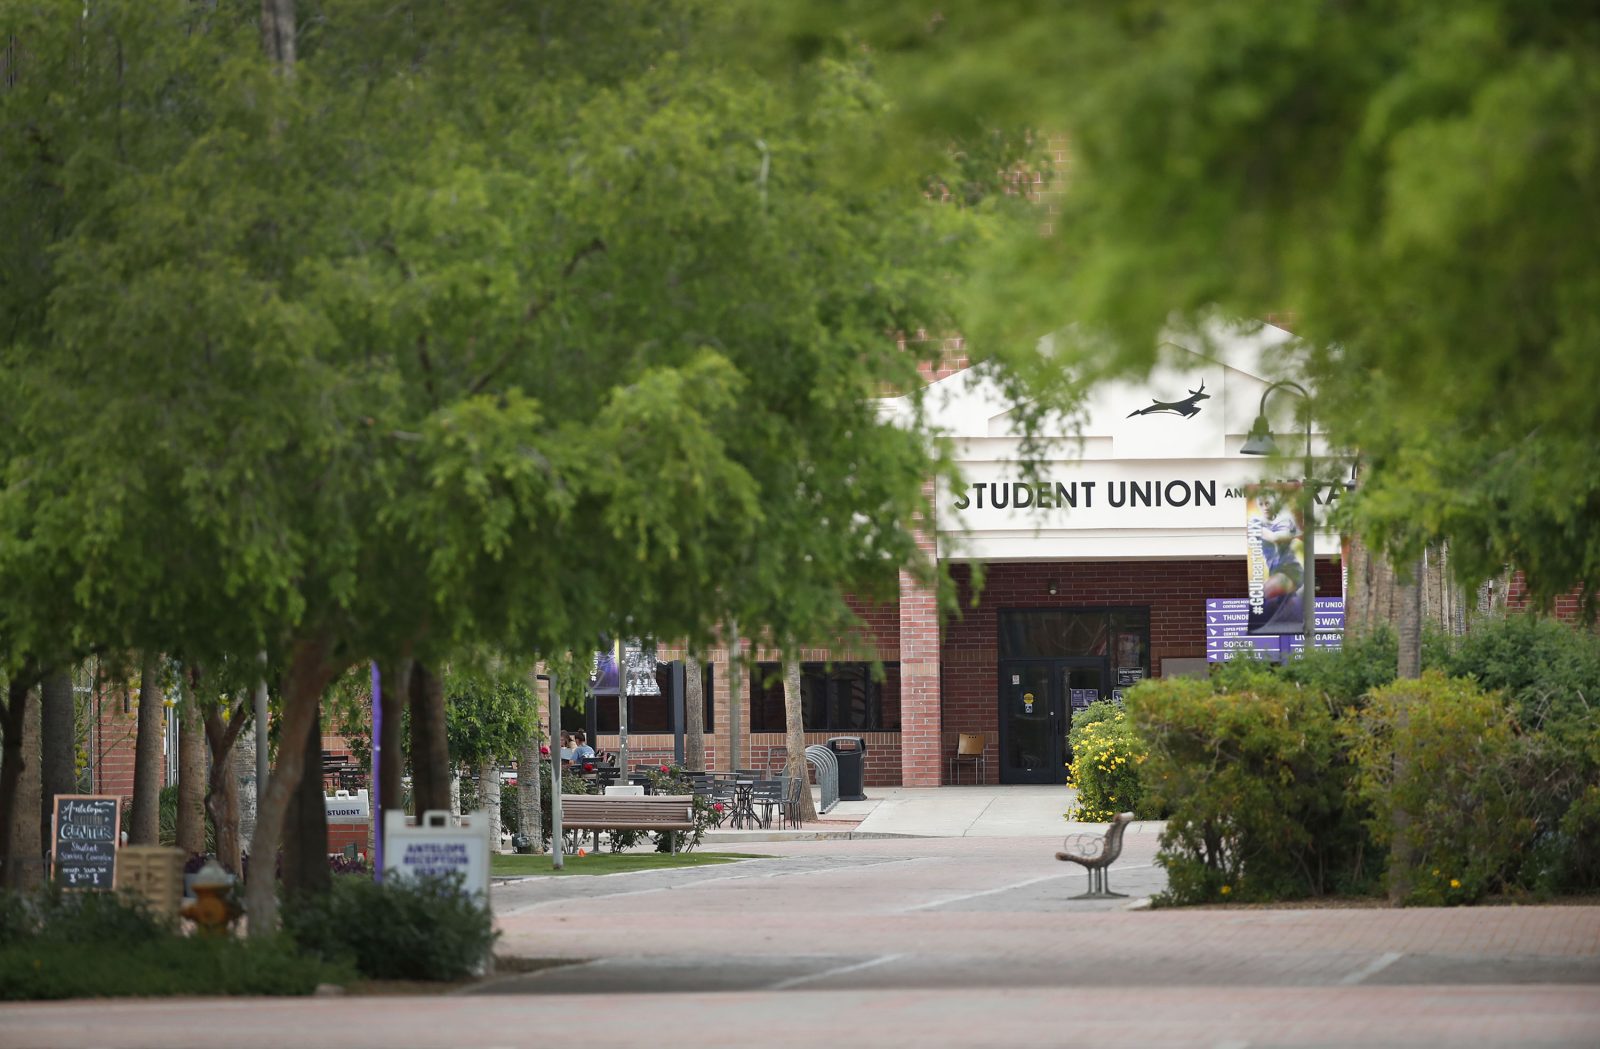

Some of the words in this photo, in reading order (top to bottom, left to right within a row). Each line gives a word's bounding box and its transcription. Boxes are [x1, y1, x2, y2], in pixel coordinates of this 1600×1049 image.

[954, 482, 1096, 509] STUDENT
[1108, 480, 1216, 508] UNION
[1224, 488, 1247, 498] AN
